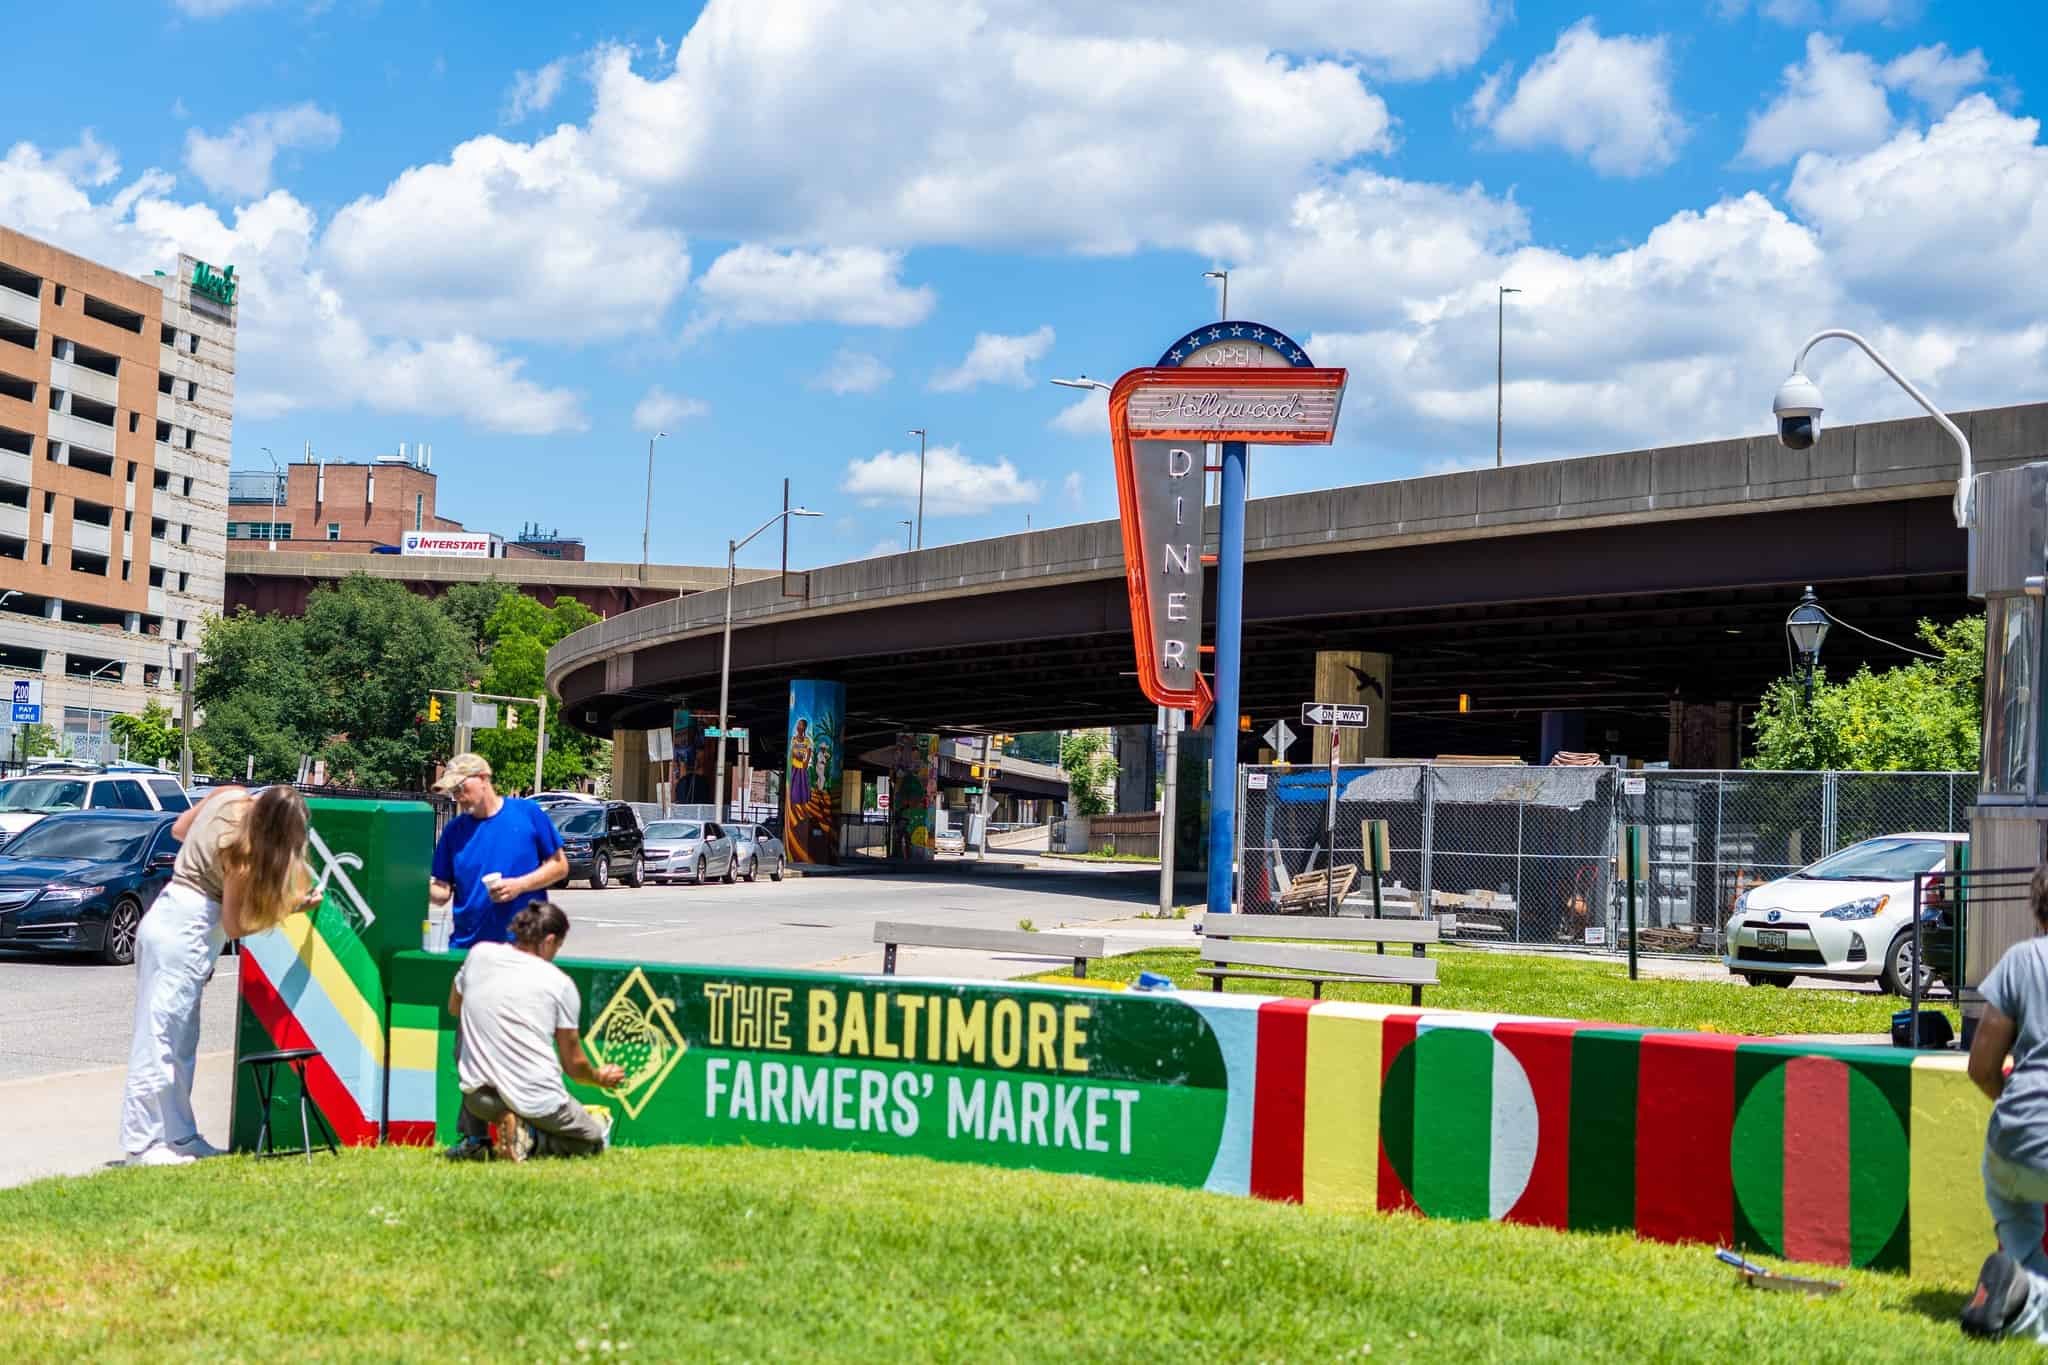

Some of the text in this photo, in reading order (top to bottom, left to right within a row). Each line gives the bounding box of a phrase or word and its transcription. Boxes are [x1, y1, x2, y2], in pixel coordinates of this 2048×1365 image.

[1156, 393, 1305, 425] Hollywood
[419, 537, 487, 550] INTERSTATE
[1163, 449, 1193, 669] DINER
[1342, 711, 1360, 720] WAY
[704, 982, 1091, 1072] THE BALTIMORE
[705, 1057, 1141, 1155] FARMERS' MARKET
